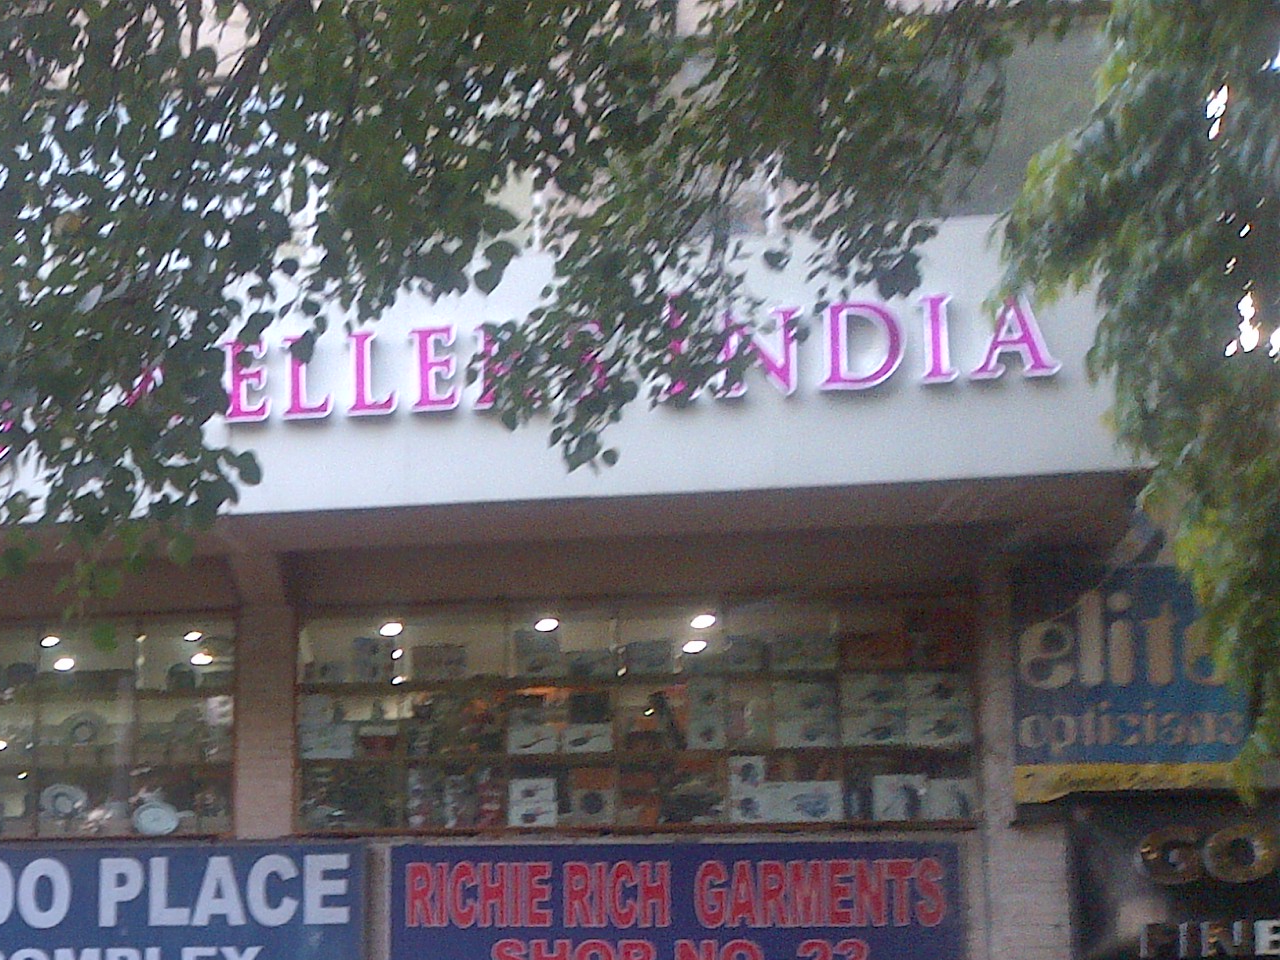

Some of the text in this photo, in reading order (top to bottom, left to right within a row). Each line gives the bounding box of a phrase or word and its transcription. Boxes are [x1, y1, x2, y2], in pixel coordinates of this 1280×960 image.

[97, 852, 351, 928] PLACE
[405, 857, 948, 930] RICHIE RICH GARMENTS
